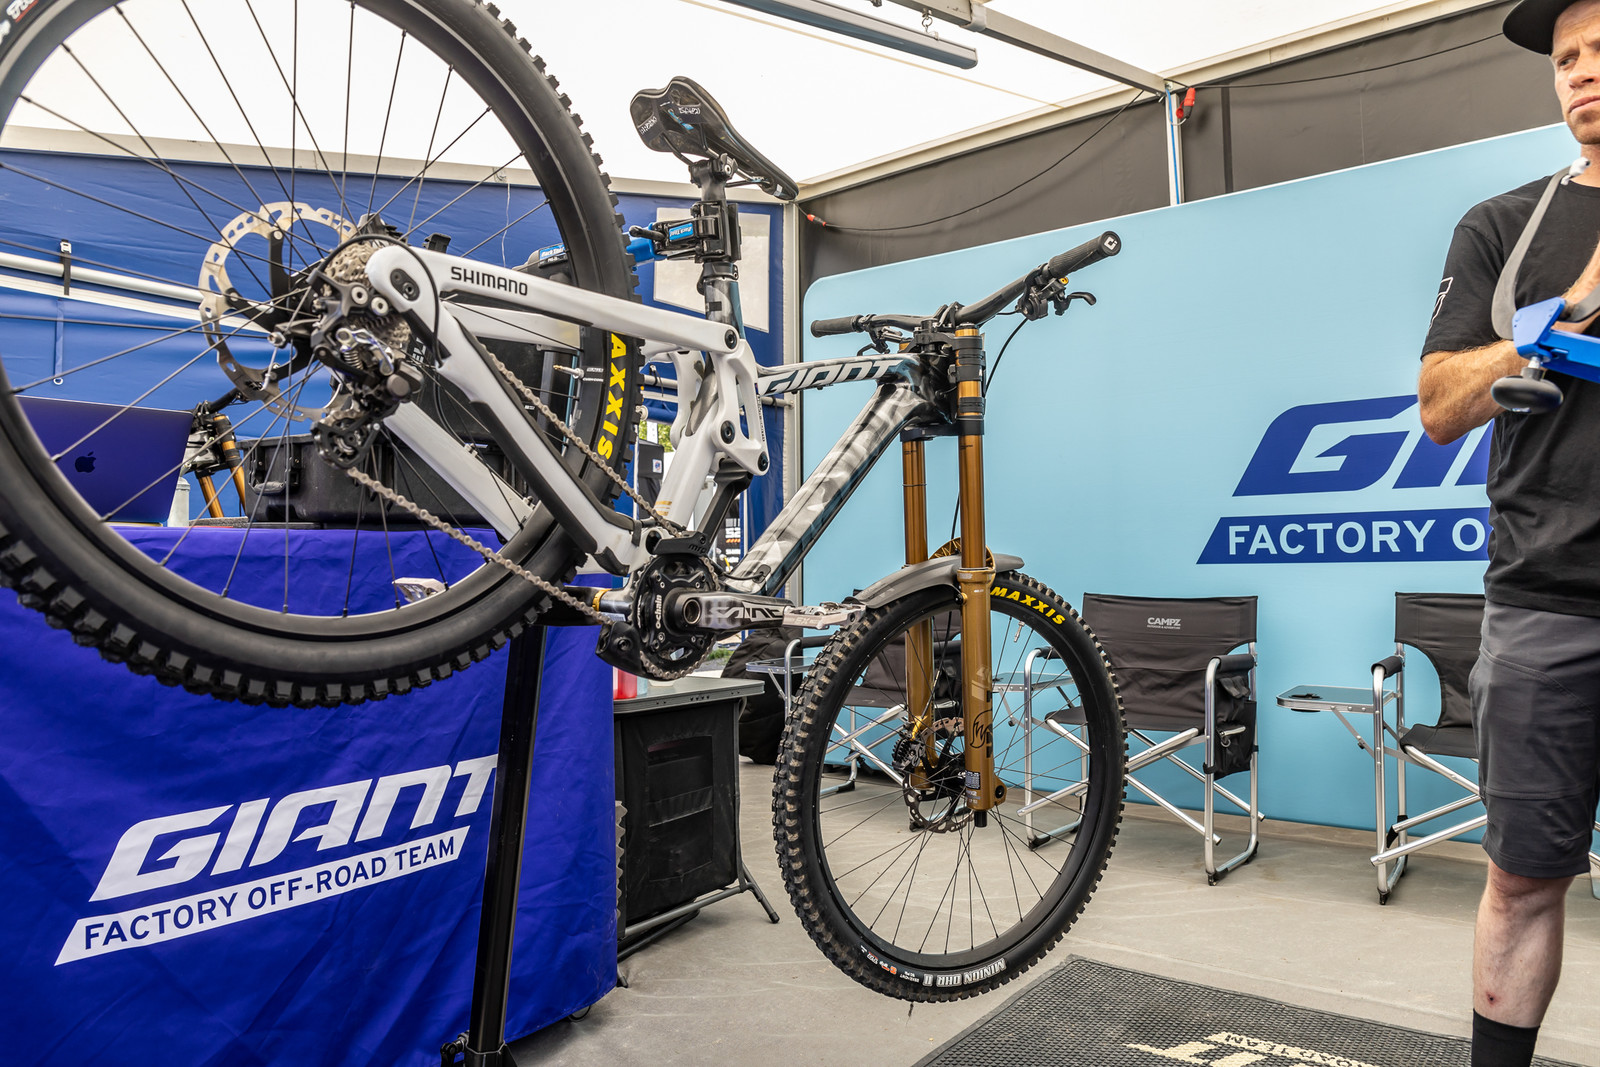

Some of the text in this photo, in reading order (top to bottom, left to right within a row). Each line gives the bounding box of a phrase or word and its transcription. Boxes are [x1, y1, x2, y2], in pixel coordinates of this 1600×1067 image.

[451, 266, 528, 296] SHIMANO
[597, 333, 627, 459] AXXIS
[758, 359, 903, 397] GIANT
[1229, 519, 1436, 555] FACTORY
[990, 586, 1066, 625] MAXXIS
[1147, 617, 1181, 627] CAMPZ
[89, 754, 498, 902] GIANT
[85, 836, 455, 950] FACTORY OFF-ROAD TEAM
[963, 958, 1007, 985] MINION
